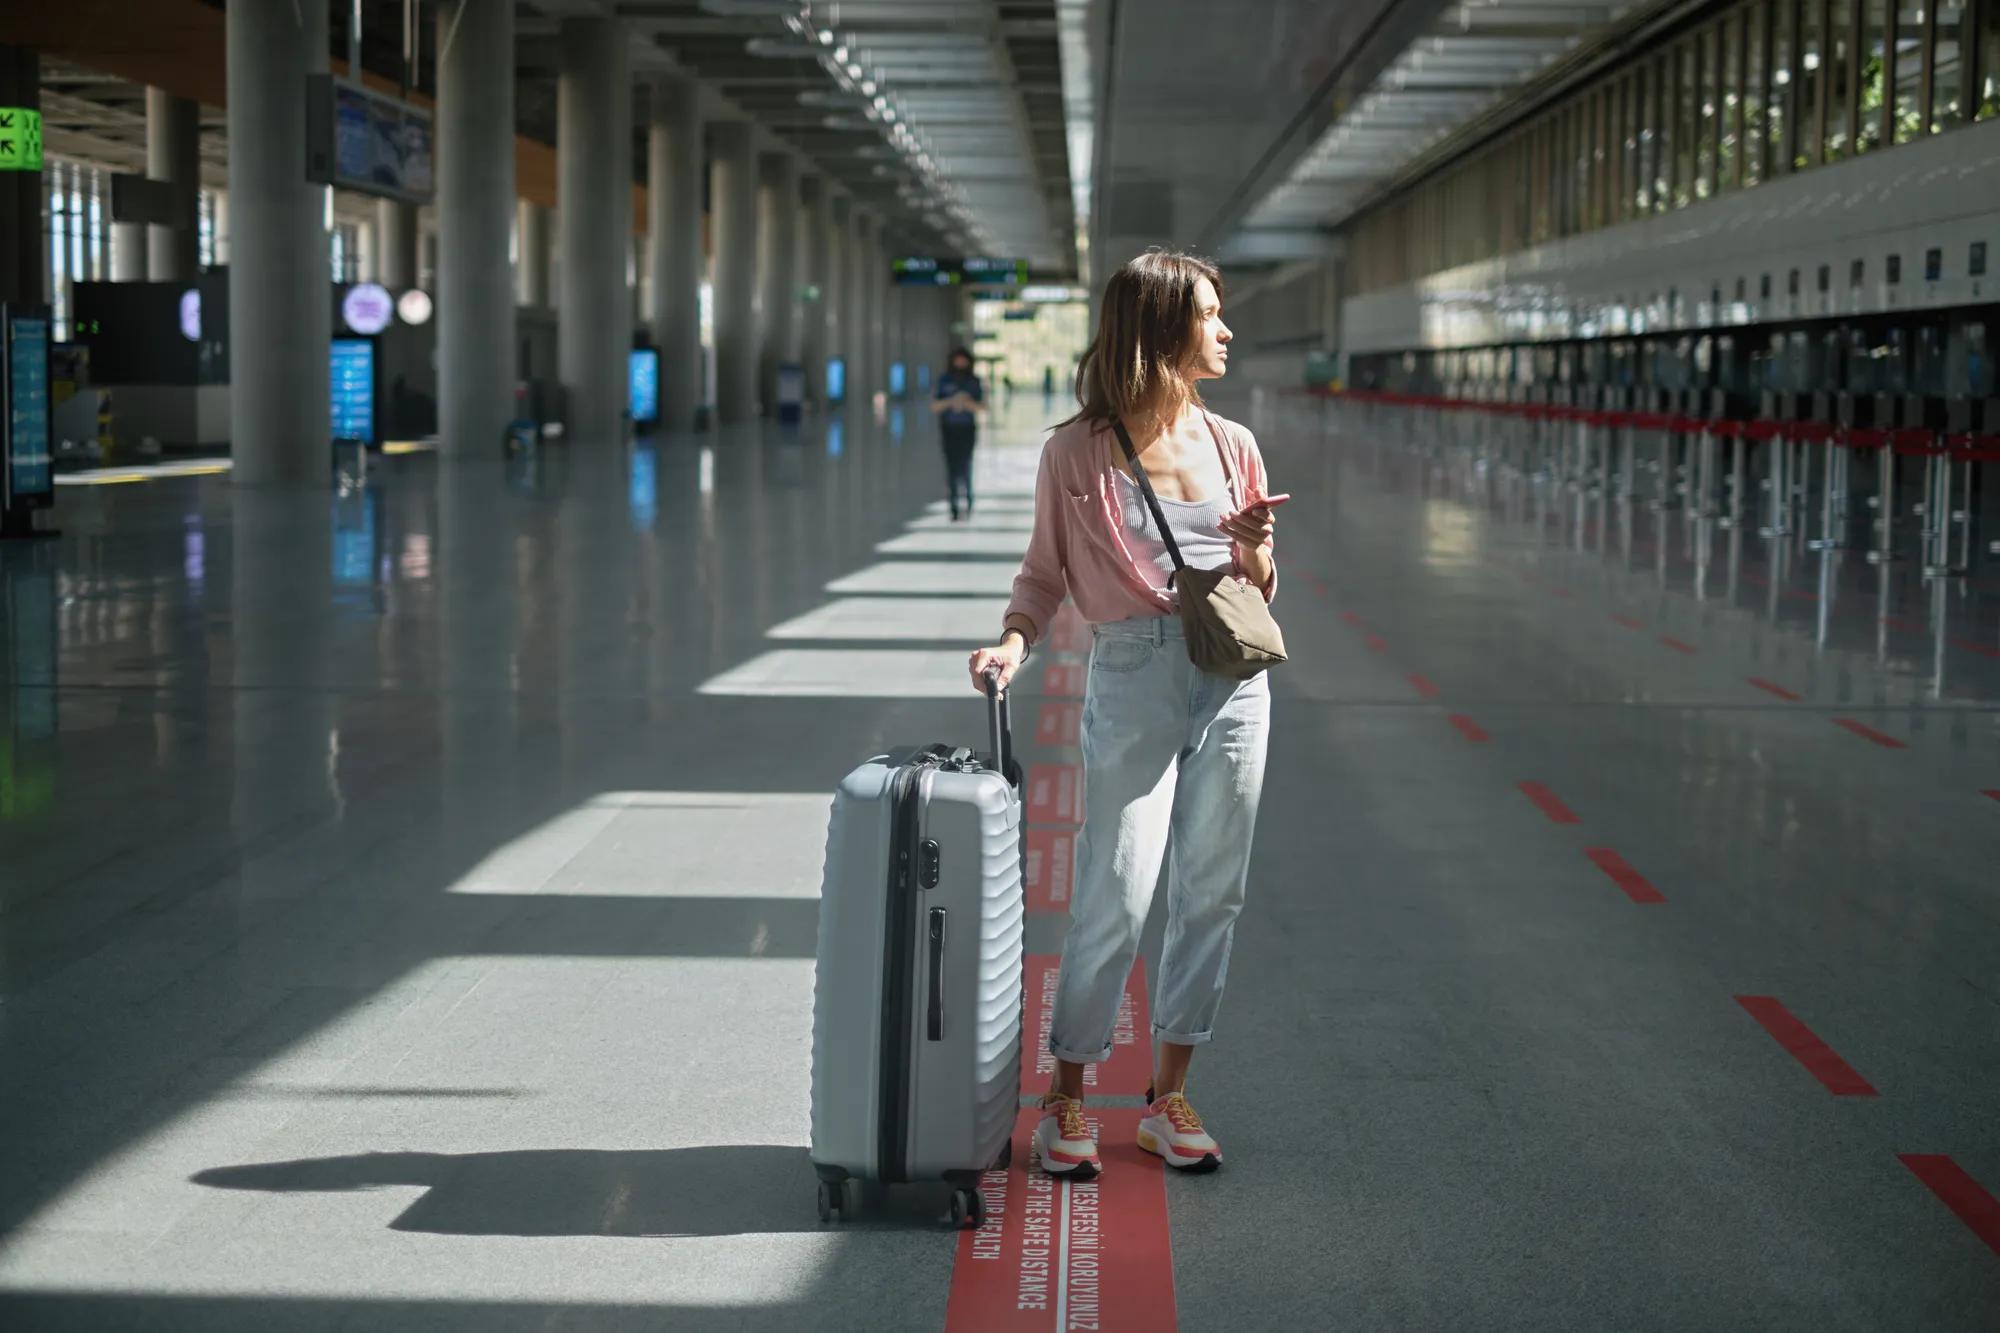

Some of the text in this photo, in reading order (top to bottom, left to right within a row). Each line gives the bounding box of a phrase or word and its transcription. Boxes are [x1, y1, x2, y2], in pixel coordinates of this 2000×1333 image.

[972, 1168, 1008, 1260] OR YOUR HEALTH
[1023, 1217, 1051, 1245] SAFE
[1025, 1195, 1052, 1214] THE
[1071, 1183, 1105, 1249] MESAFESİNİ
[1017, 1249, 1049, 1309] DISTANCE
[1069, 1253, 1099, 1330] KORUYUNUZ
